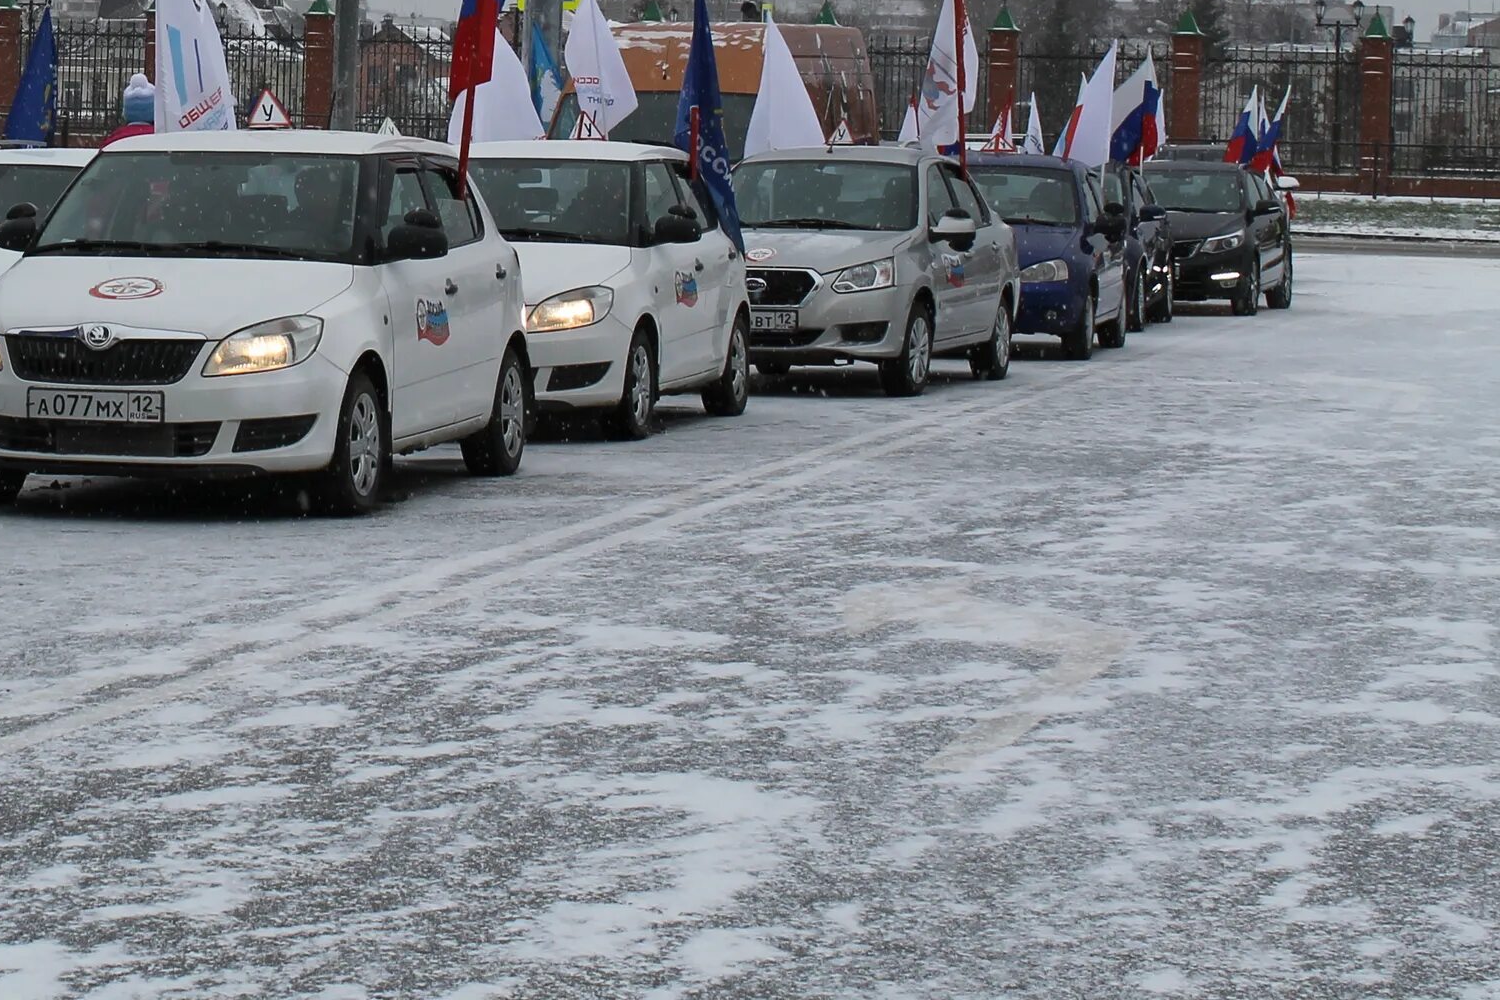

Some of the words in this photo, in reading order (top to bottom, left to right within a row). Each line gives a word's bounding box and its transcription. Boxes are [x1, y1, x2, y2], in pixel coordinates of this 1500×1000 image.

[262, 104, 274, 121] У
[584, 123, 592, 137] У
[837, 128, 846, 141] У
[778, 313, 792, 325] 12
[132, 395, 153, 412] 12
[129, 412, 146, 420] RUS
